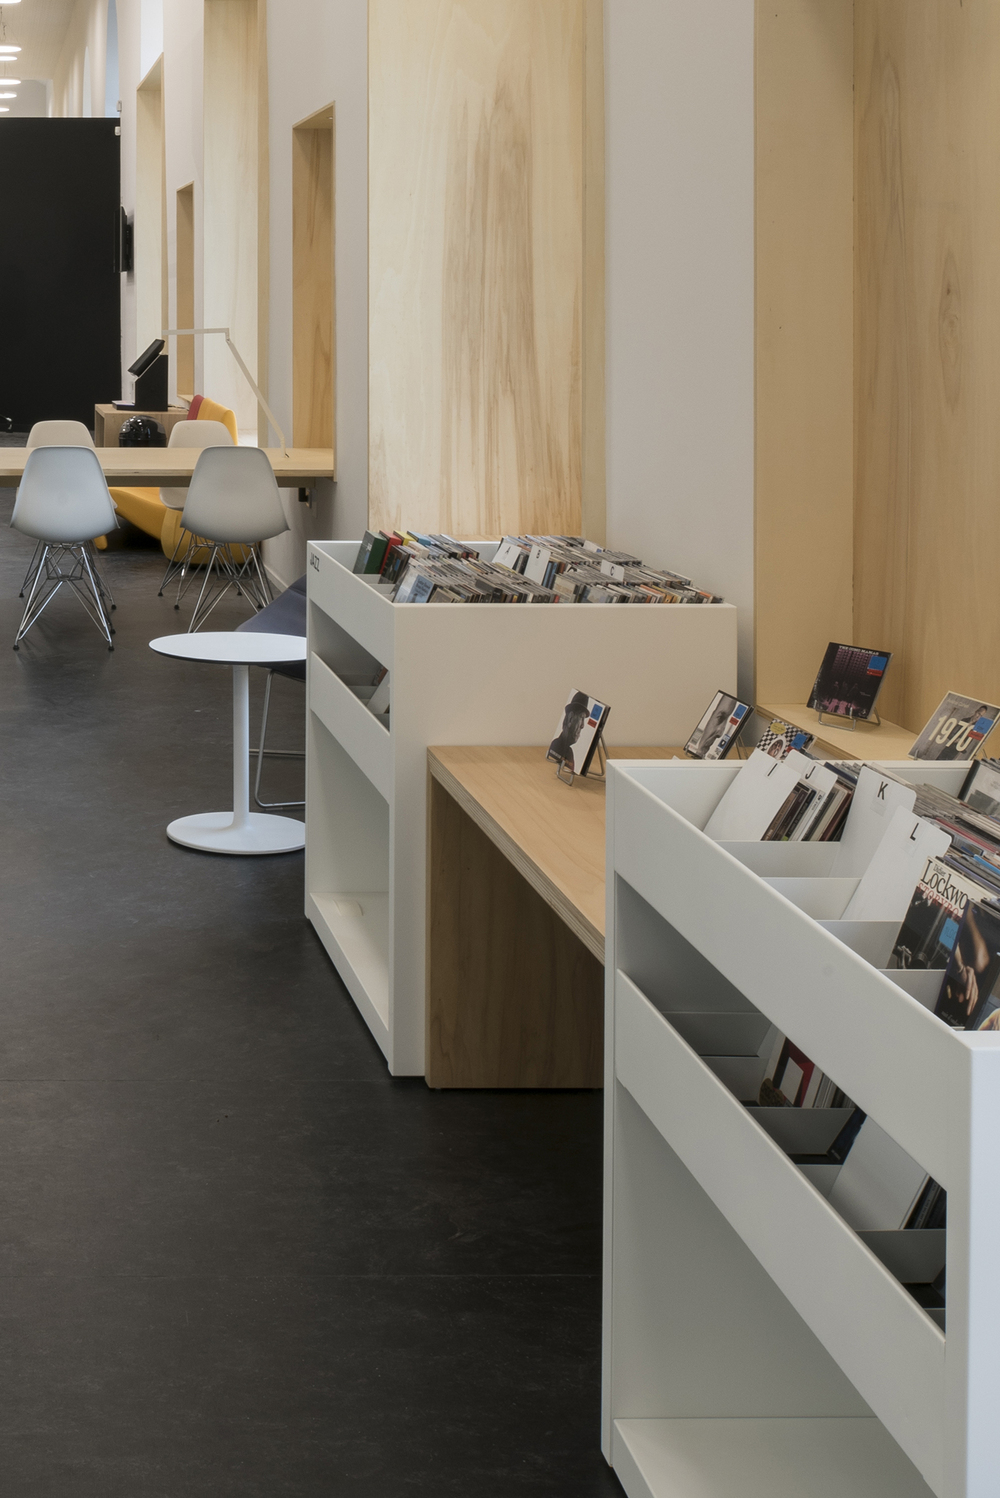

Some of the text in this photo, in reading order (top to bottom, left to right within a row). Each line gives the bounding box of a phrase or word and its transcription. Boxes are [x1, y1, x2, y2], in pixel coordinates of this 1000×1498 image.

[309, 552, 320, 572] JAZZ
[928, 715, 975, 752] 1970
[804, 765, 816, 780] J
[877, 781, 888, 800] K
[909, 822, 920, 841] L
